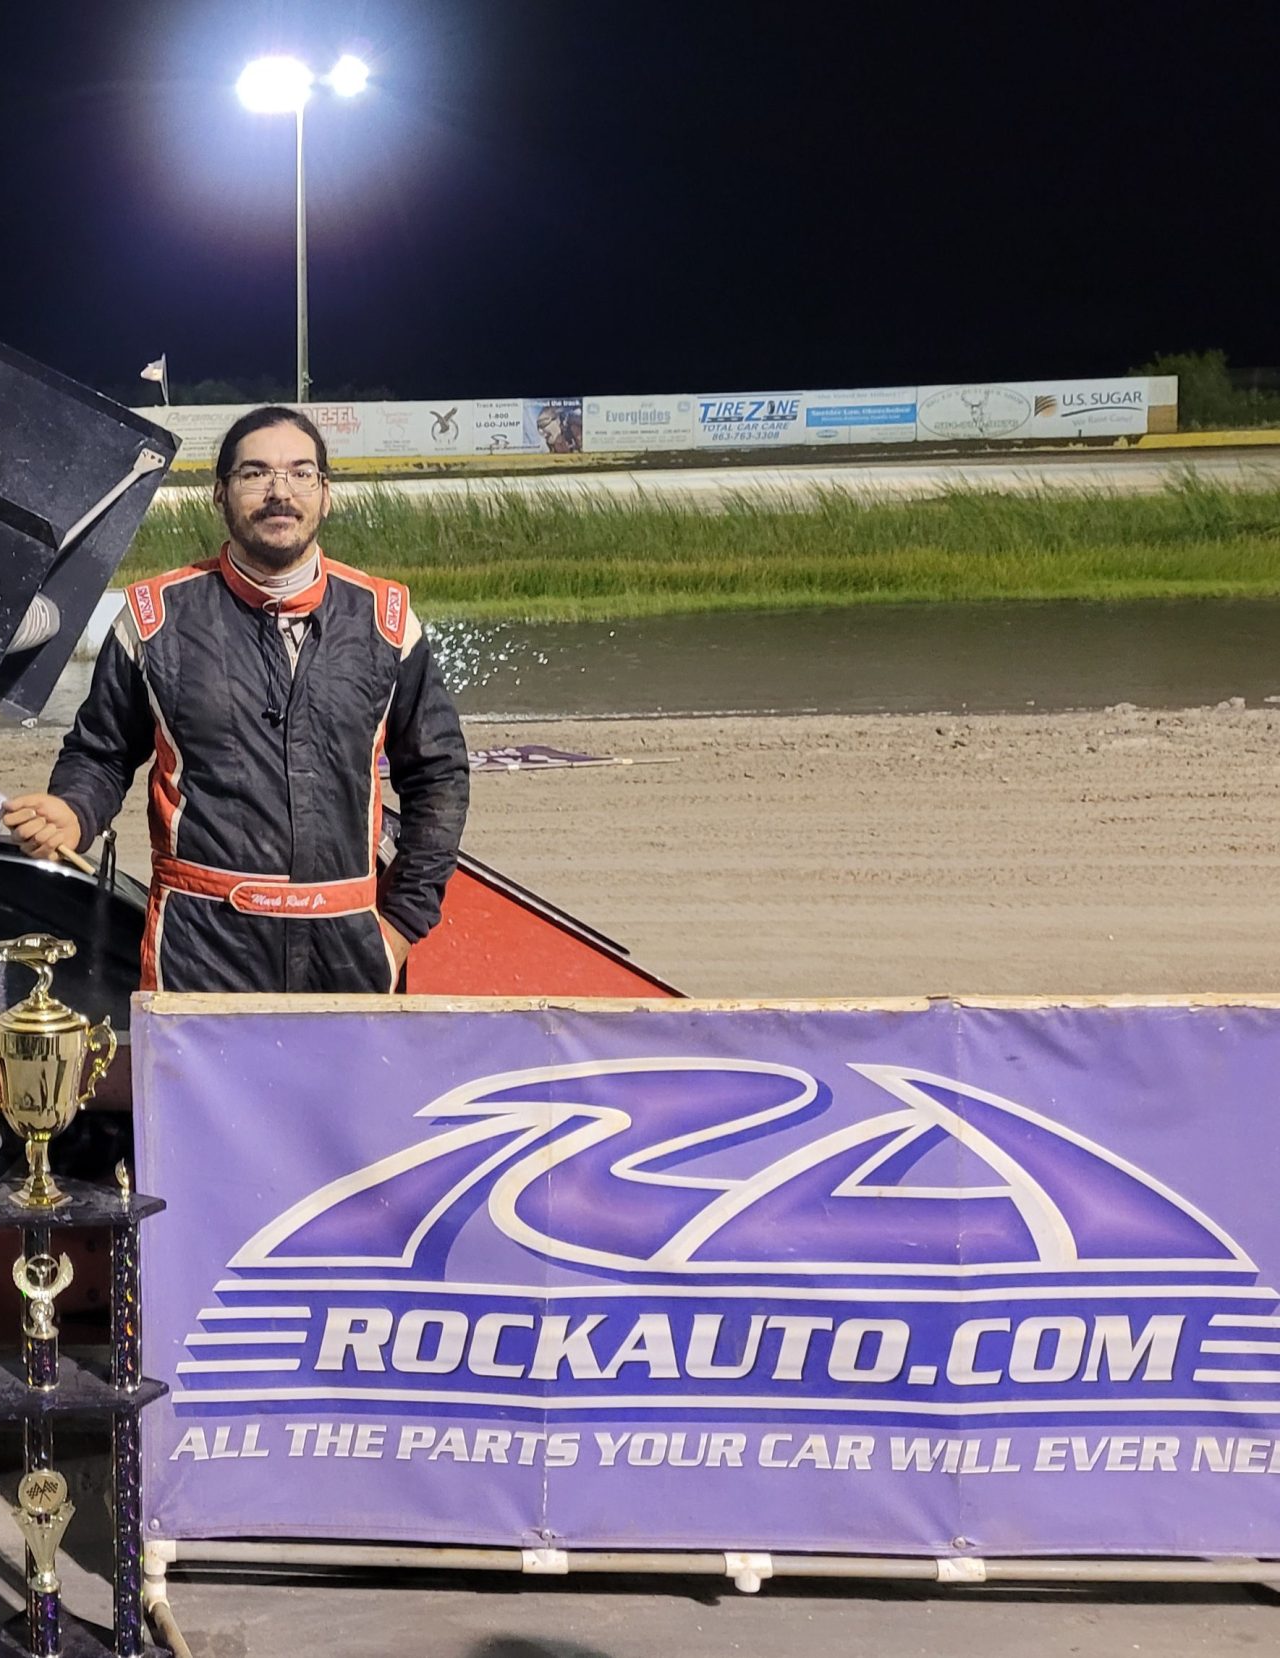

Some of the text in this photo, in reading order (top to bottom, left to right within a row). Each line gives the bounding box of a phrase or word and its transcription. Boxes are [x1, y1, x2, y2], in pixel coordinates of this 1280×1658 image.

[700, 401, 746, 423] TIRE
[1062, 391, 1143, 407] U.S. SUGAR
[166, 411, 238, 425] Paramoun
[703, 422, 790, 432] TOTAL CAR CARE
[137, 587, 154, 623] SIMPSON
[387, 588, 400, 630] SIMPSON
[314, 1307, 1187, 1386] ROCKAUTO.COM
[170, 1424, 271, 1462] ALL
[284, 1423, 388, 1460] THE
[395, 1426, 582, 1468] PARTS
[593, 1431, 748, 1468] YOUR
[757, 1433, 876, 1471] CAR
[889, 1435, 1021, 1474] WILL
[1033, 1437, 1180, 1472] EVER
